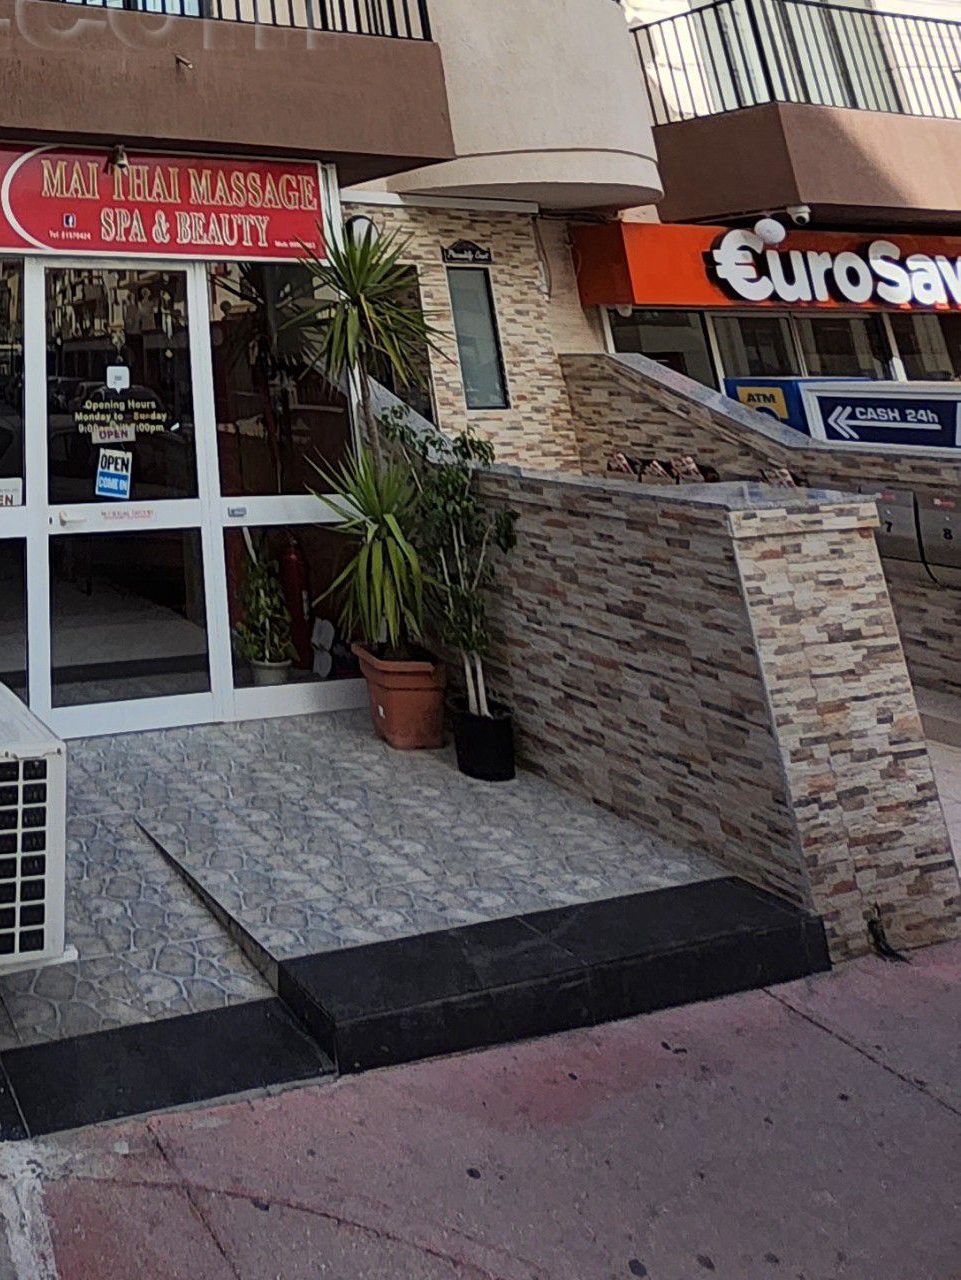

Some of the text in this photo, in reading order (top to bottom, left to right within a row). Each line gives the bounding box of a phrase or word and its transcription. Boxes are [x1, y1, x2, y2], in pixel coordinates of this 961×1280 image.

[41, 159, 317, 211] MAI THAI MASSAGE
[100, 207, 269, 248] SPA & BEAUTY
[747, 392, 777, 404] ATM
[85, 399, 156, 412] Opening Hours
[74, 411, 111, 424] Monday
[113, 411, 124, 421] to
[855, 406, 939, 424] CASH 24h
[99, 430, 128, 440] OPEN
[100, 454, 129, 473] OPEN
[885, 521, 893, 532] 7
[942, 528, 953, 540] 8
